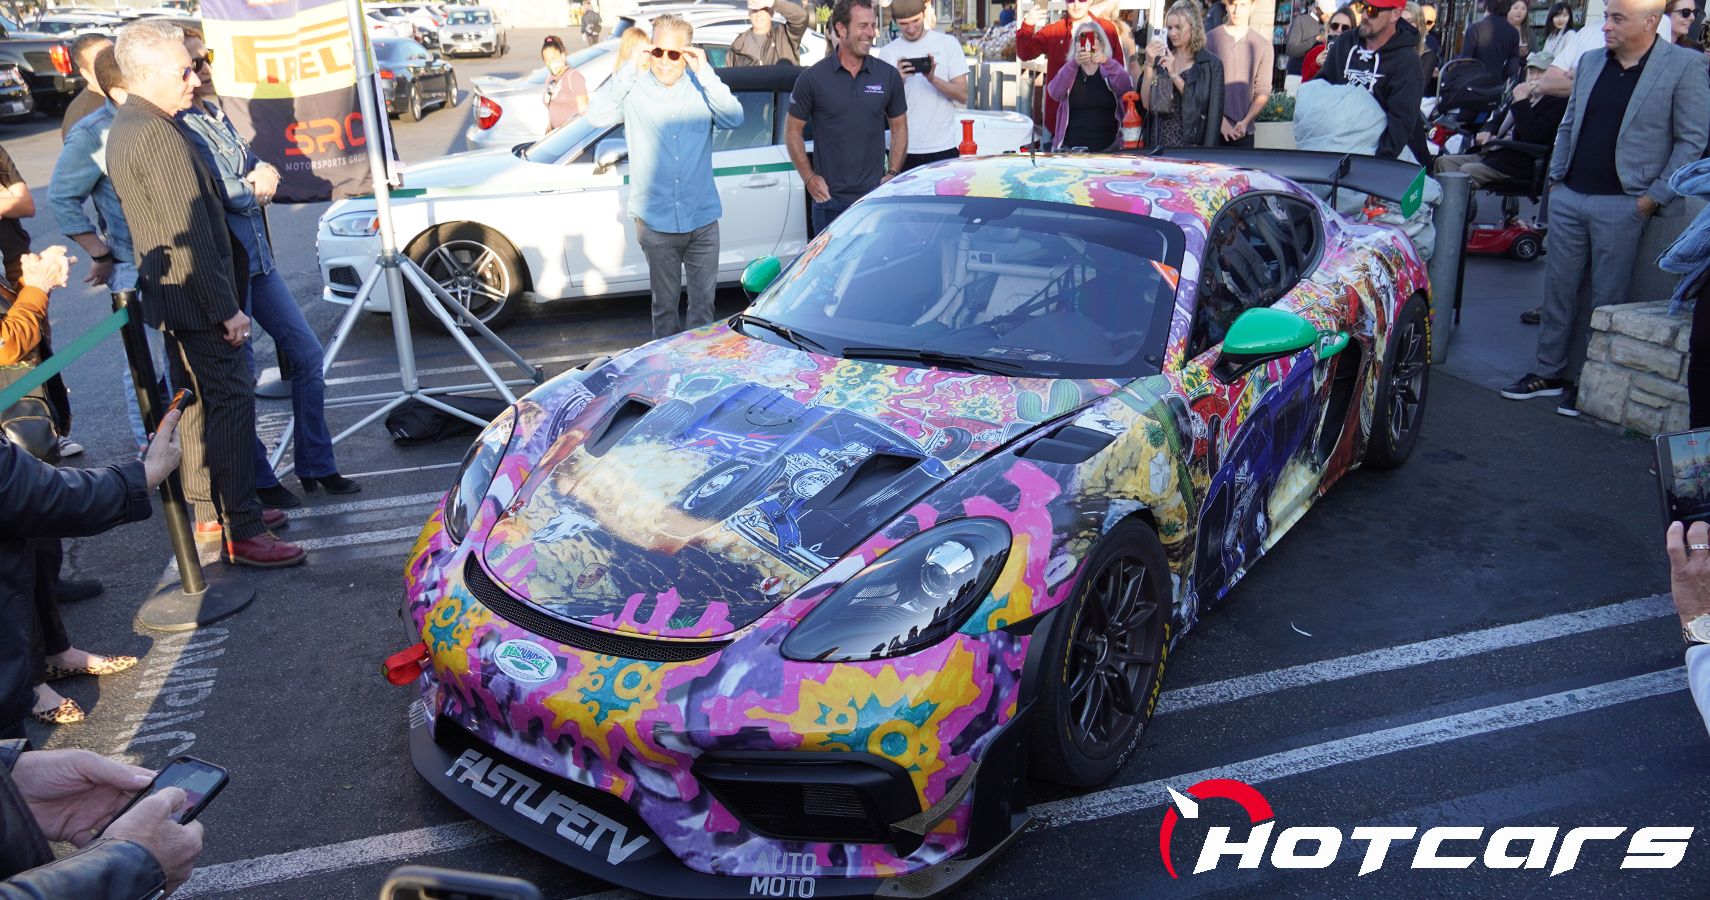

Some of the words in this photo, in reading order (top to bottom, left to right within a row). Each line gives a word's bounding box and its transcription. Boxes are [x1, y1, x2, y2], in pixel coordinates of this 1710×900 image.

[232, 16, 352, 83] PIREL
[285, 157, 347, 171] MOTORSPORTS
[349, 154, 367, 164] GROU
[698, 427, 777, 453] TRG
[752, 851, 817, 875] AUTO
[749, 876, 816, 899] MOTO
